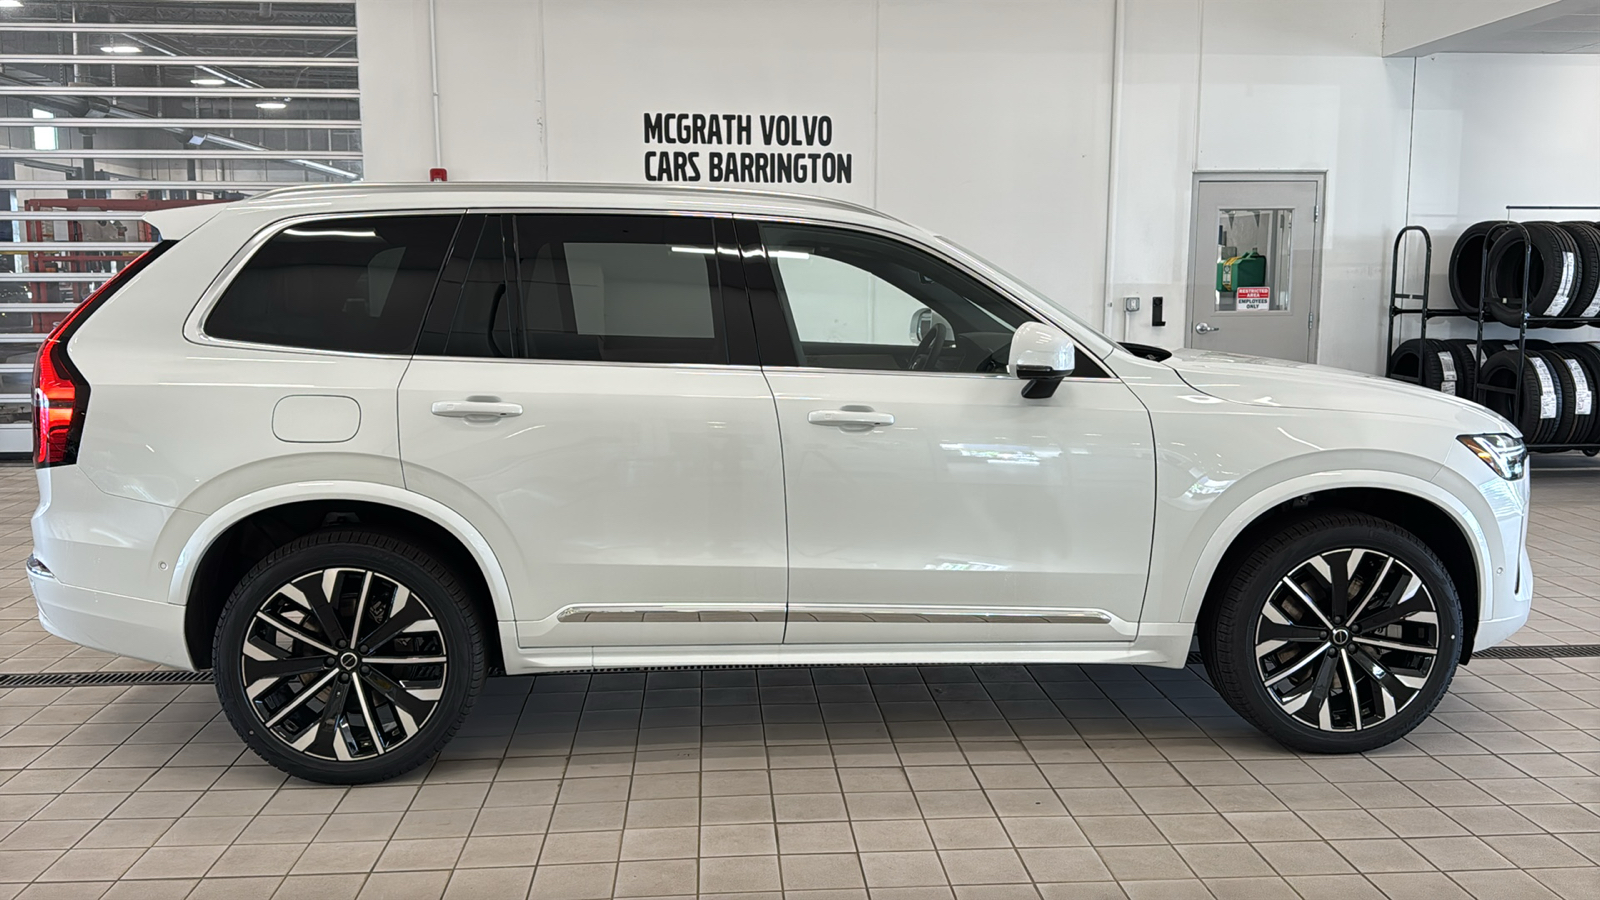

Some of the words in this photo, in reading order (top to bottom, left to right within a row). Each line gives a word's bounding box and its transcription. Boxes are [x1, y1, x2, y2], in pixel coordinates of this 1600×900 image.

[644, 113, 751, 145] MCGRATH
[760, 115, 832, 146] VOLVO
[645, 151, 701, 182] CARS
[709, 152, 852, 184] BARRINGTON
